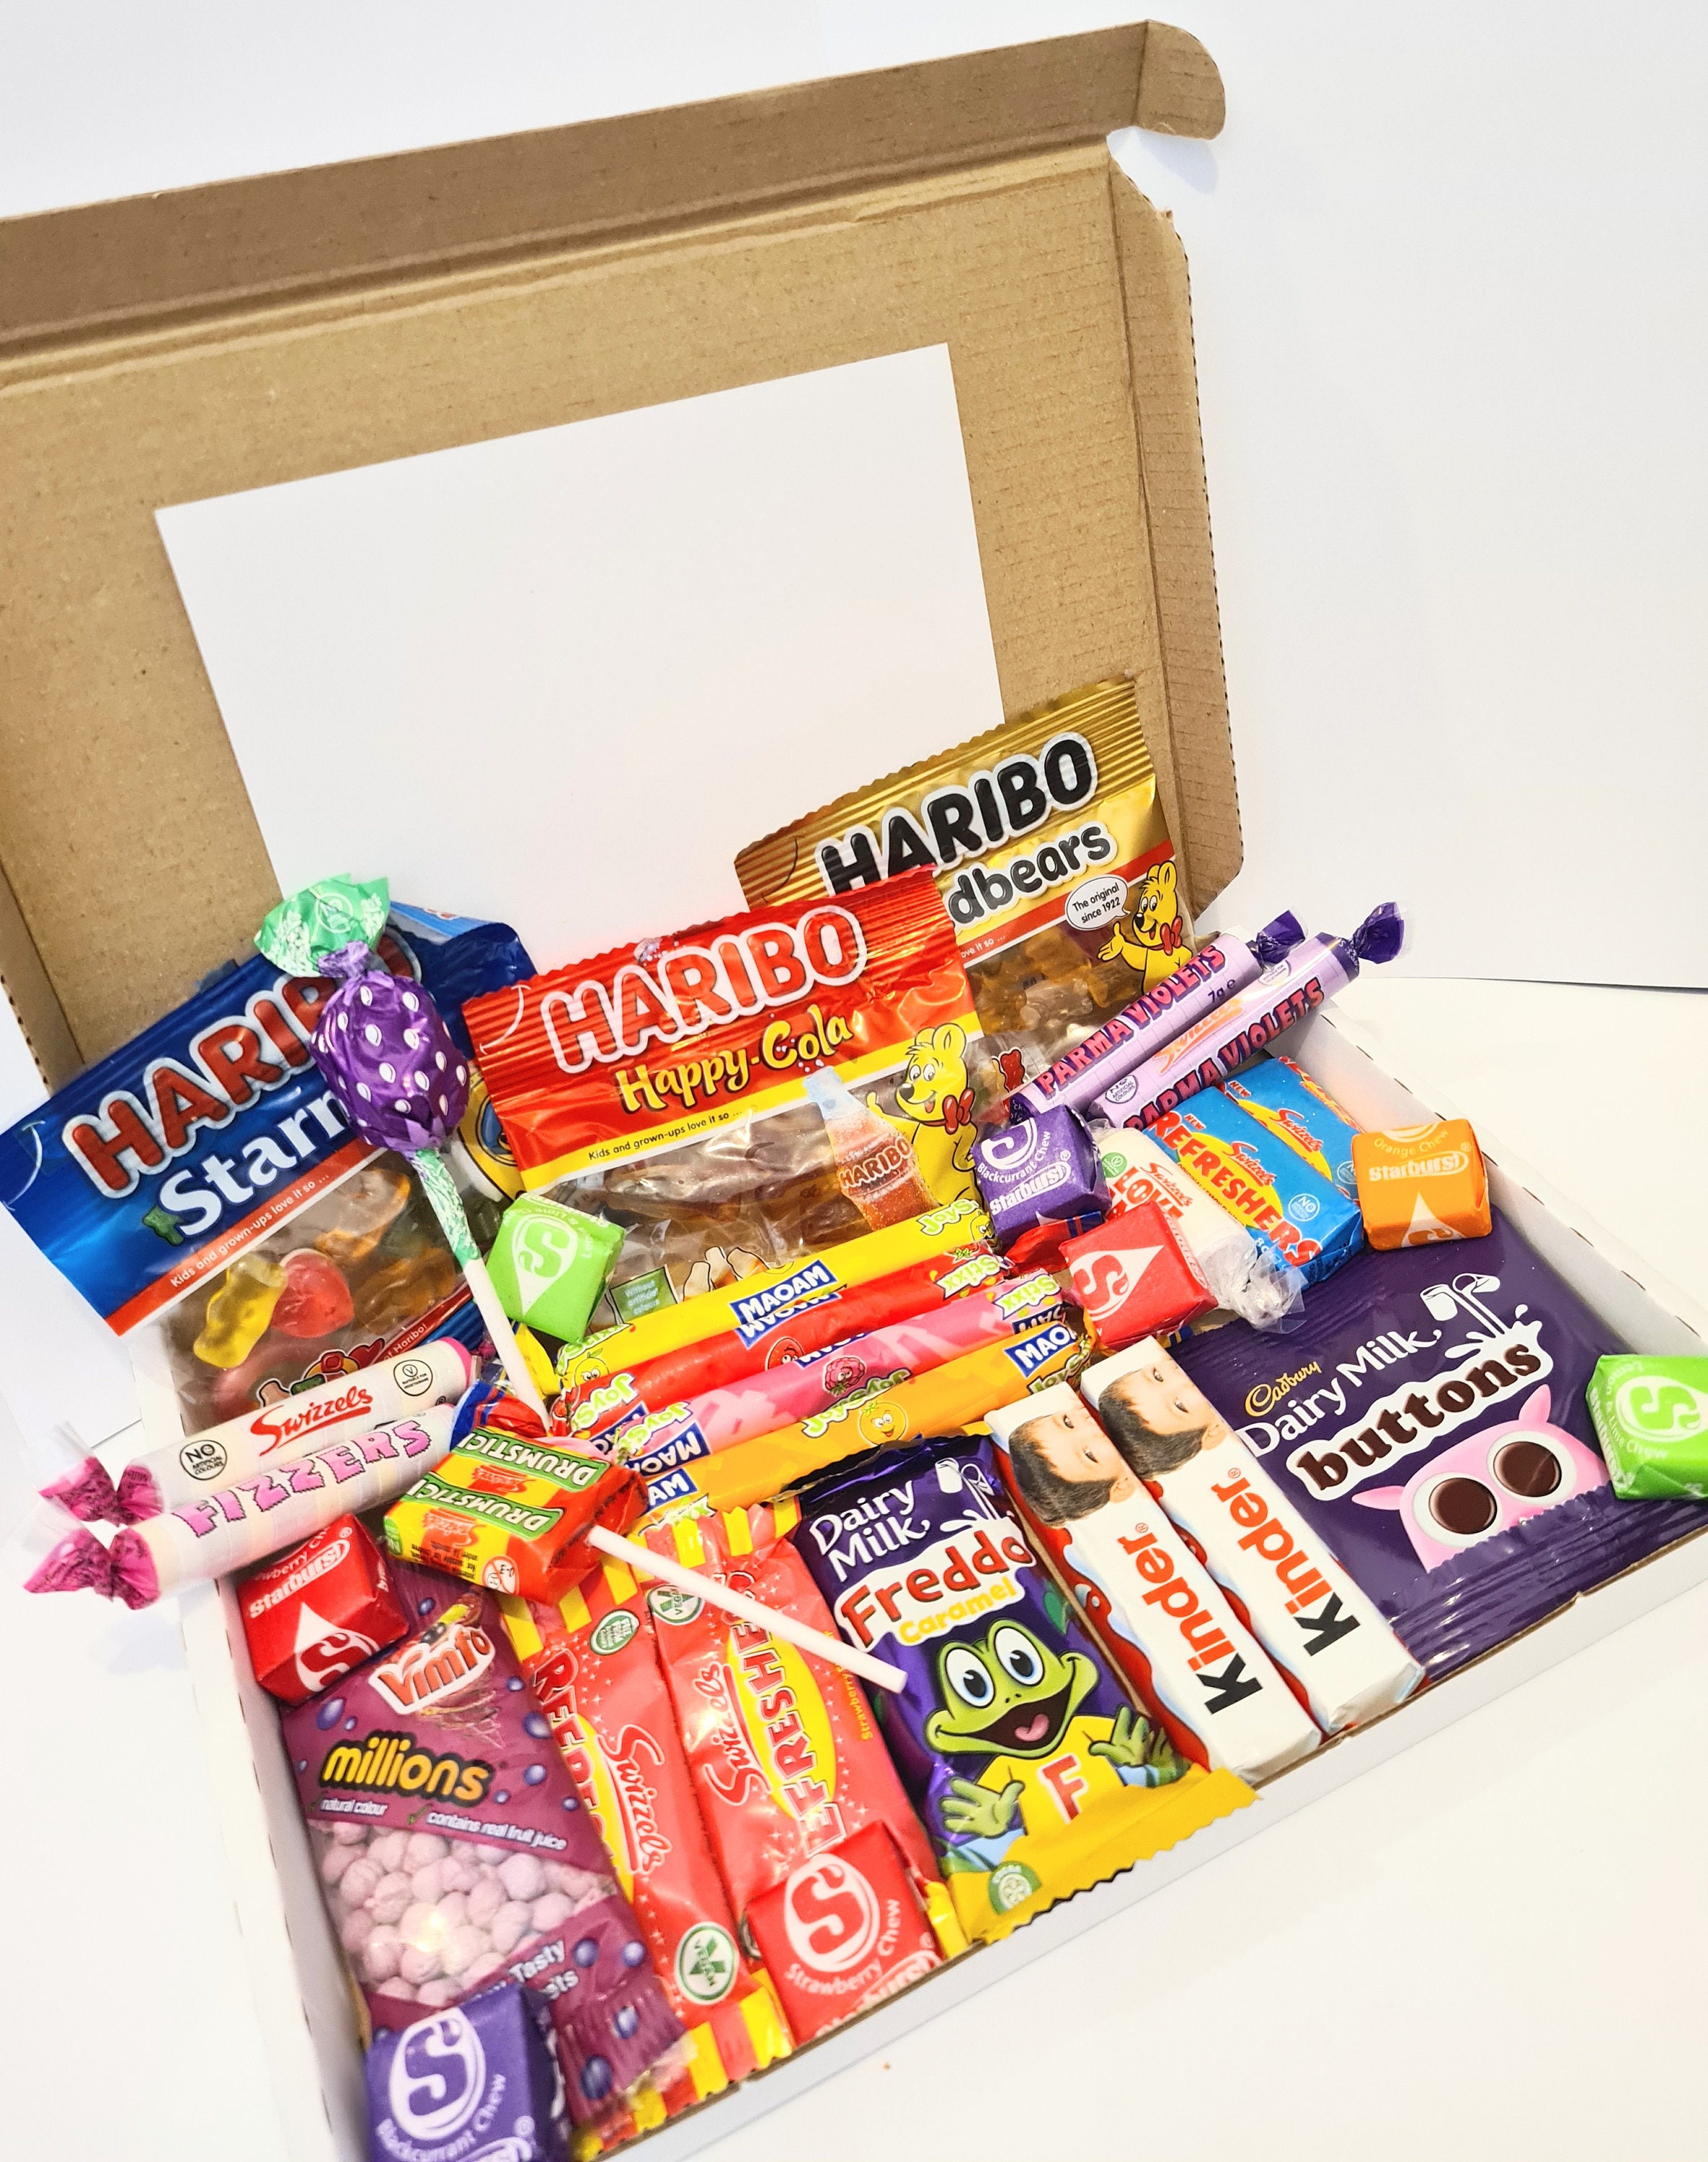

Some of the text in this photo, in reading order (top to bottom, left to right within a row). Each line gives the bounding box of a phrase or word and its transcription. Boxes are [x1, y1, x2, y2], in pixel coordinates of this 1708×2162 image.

[817, 735, 1096, 896] HARIBO
[948, 825, 1113, 924] dbears
[1072, 882, 1119, 912] The original
[1081, 897, 1121, 923] since 1922
[961, 948, 975, 958] ove
[541, 907, 867, 1072] HARIBO
[1036, 945, 1226, 1100] PARMA VIOLETS
[1217, 977, 1325, 1073] VIOLETS
[615, 1006, 852, 1115] Happy-Cola
[1112, 1081, 1134, 1098] ARTIFICIAL
[1229, 1081, 1250, 1097] NEW
[1115, 1085, 1136, 1101] COLOURS
[1185, 1114, 1206, 1130] NEW
[588, 1149, 610, 1160] Kids
[613, 1142, 631, 1154] and
[633, 1126, 685, 1149] grown-ups
[687, 1118, 707, 1131] love
[708, 1115, 716, 1124] it
[719, 1112, 729, 1121] so
[977, 1131, 1051, 1184] Blackcurrant Chew
[1269, 1108, 1324, 1152] Swizzels
[1374, 1129, 1449, 1158] Orange Chew
[840, 1137, 914, 1190] HARIBO
[989, 1164, 1069, 1216] Starburst
[1140, 1162, 1193, 1206] Swizzels
[1147, 1111, 1322, 1267] REFRESHERS
[1223, 1141, 1277, 1187] Swizzels
[1369, 1151, 1464, 1182] Starburst
[1298, 1194, 1317, 1213] NO
[170, 1266, 195, 1287] Kids
[196, 1250, 218, 1270] and
[218, 1210, 273, 1256] grown-ups
[270, 1194, 294, 1216] love
[294, 1188, 303, 1199] it
[303, 1180, 316, 1193] so
[738, 1265, 829, 1323] MAOAM
[393, 1323, 428, 1353] Haribo!
[1235, 1328, 1442, 1457] Dairy Milk
[1244, 1359, 1320, 1418] Cadbury
[1296, 1343, 1542, 1491] buttons
[251, 1385, 373, 1456] Swizzels
[172, 1420, 432, 1538] FIZZERS
[184, 1443, 215, 1463] NO
[192, 1454, 223, 1471] ARTIFICIAL
[194, 1460, 224, 1476] COLOURS
[809, 1480, 915, 1556] Dairy
[828, 1516, 930, 1583] Milk
[1211, 1477, 1361, 1657] Kinder
[249, 1541, 347, 1619] Starburst
[841, 1529, 1033, 1649] Freddo
[899, 1576, 1018, 1644] Caramel
[1117, 1534, 1263, 1714] Kinder
[376, 1630, 492, 1707] Vimto
[843, 1672, 873, 1741] Strawberry
[322, 1737, 489, 1801] millions
[1042, 1754, 1088, 1824] F
[321, 1799, 388, 1816] natural colour
[595, 1724, 672, 1875] Swizzels
[427, 1812, 567, 1851] contains real fruit juice
[509, 1940, 565, 1982] Tasty
[784, 1898, 900, 1996] Strawberry Chew
[473, 2073, 507, 2132] Chew
